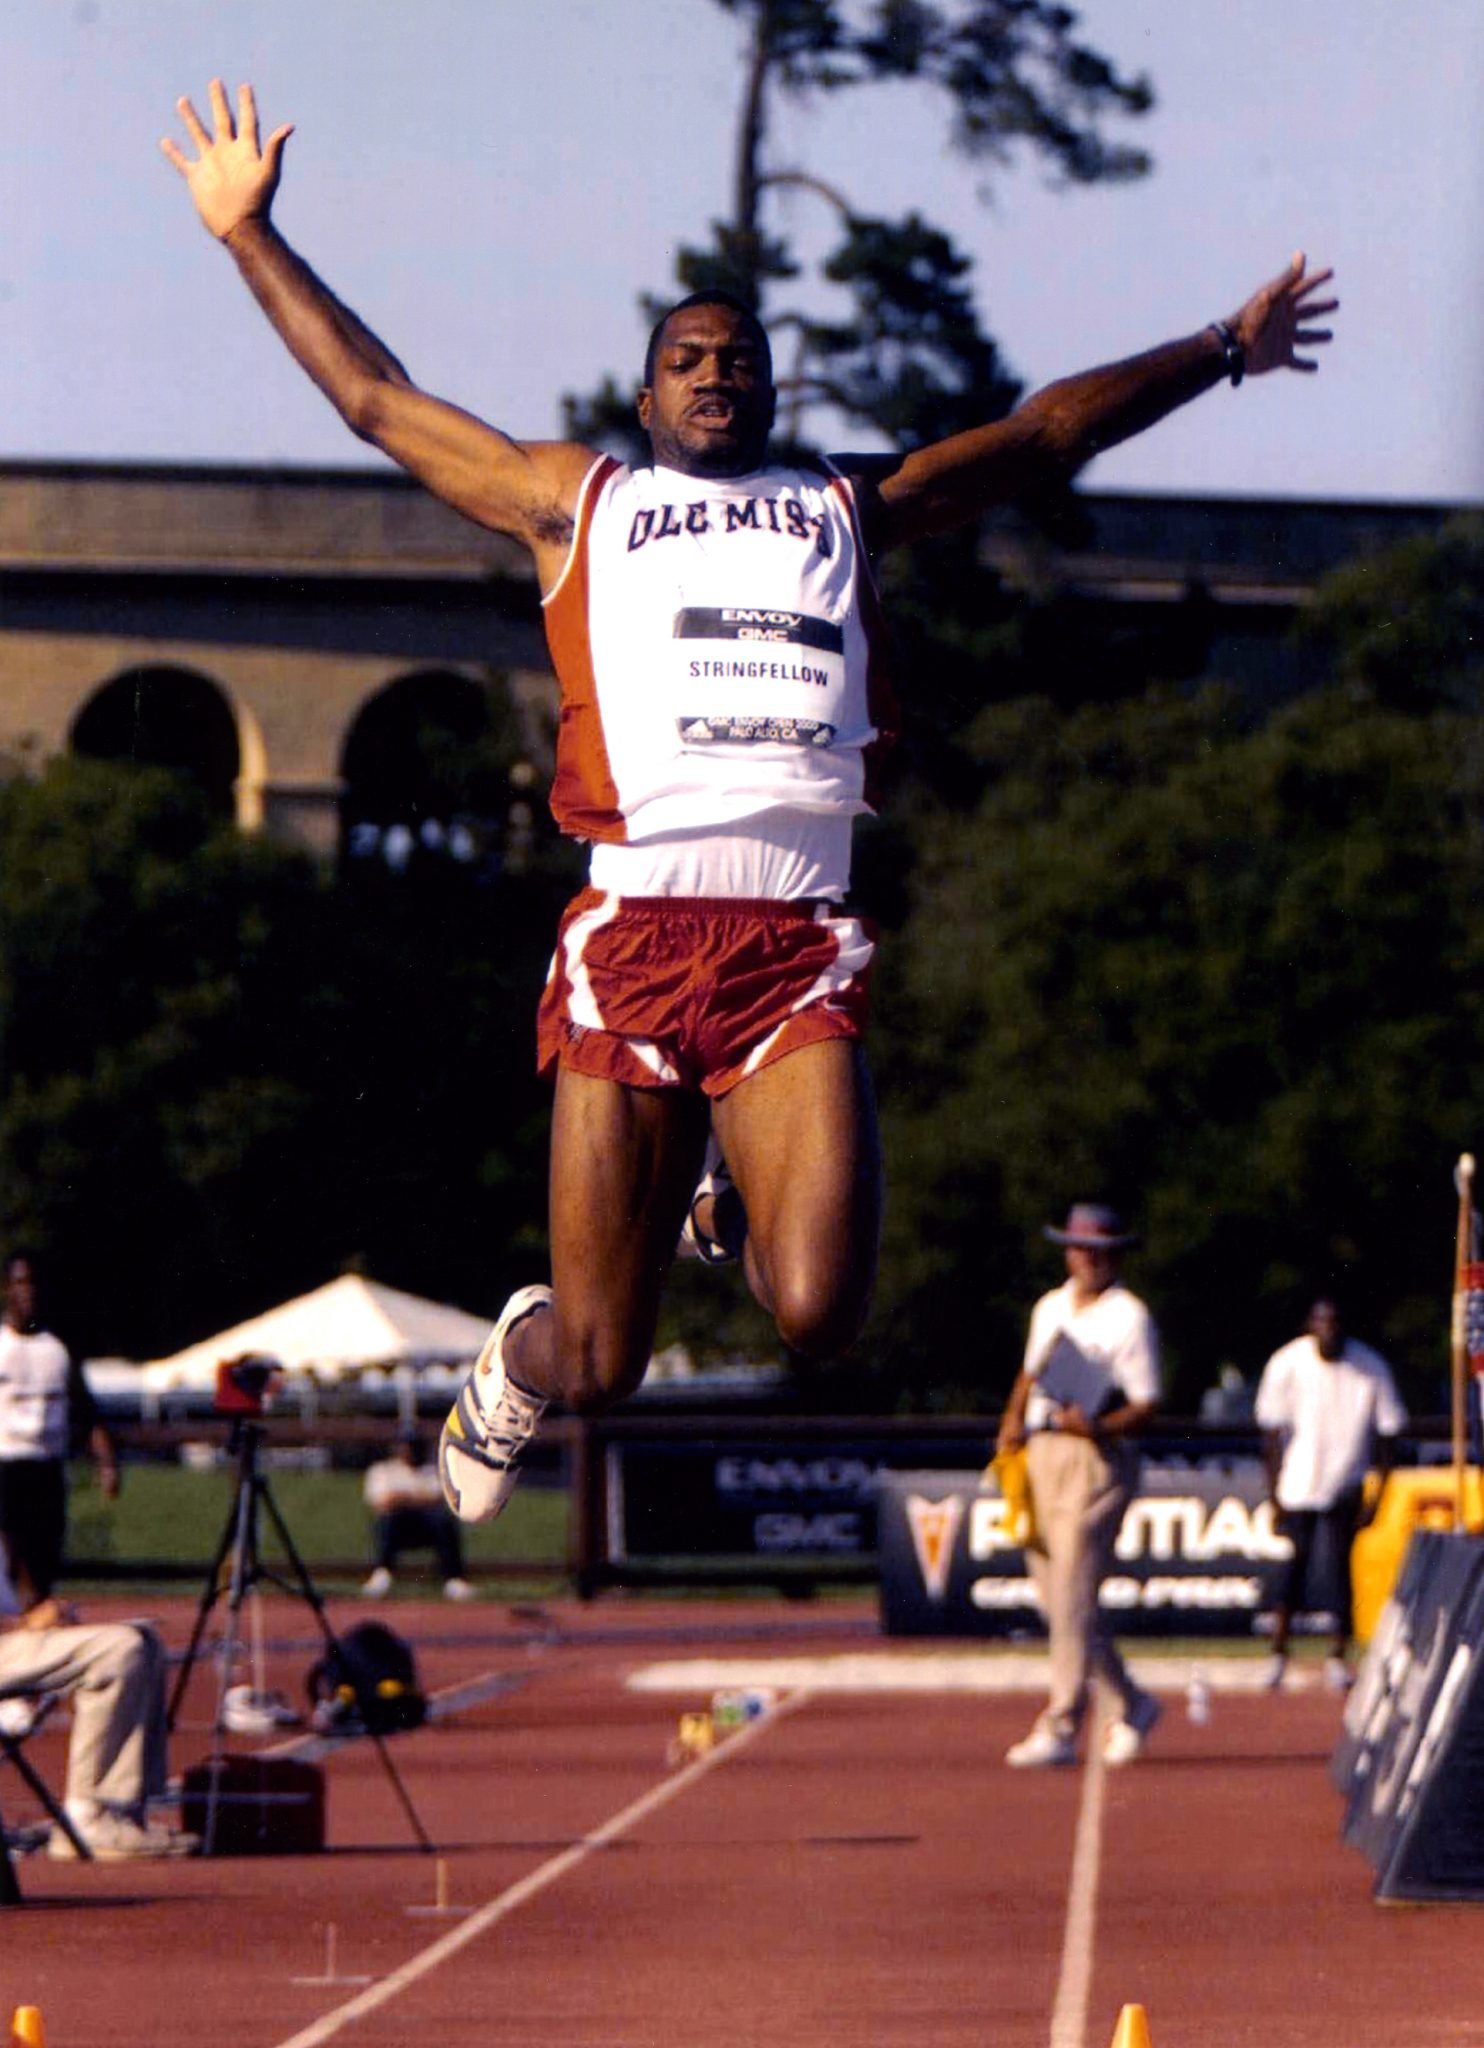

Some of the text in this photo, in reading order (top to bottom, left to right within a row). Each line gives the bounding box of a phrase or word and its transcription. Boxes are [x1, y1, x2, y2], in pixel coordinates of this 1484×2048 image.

[627, 499, 709, 552] OLE
[721, 608, 803, 627] ENVOY
[737, 628, 789, 642] GMC
[690, 660, 829, 687] STRINGFELLOW
